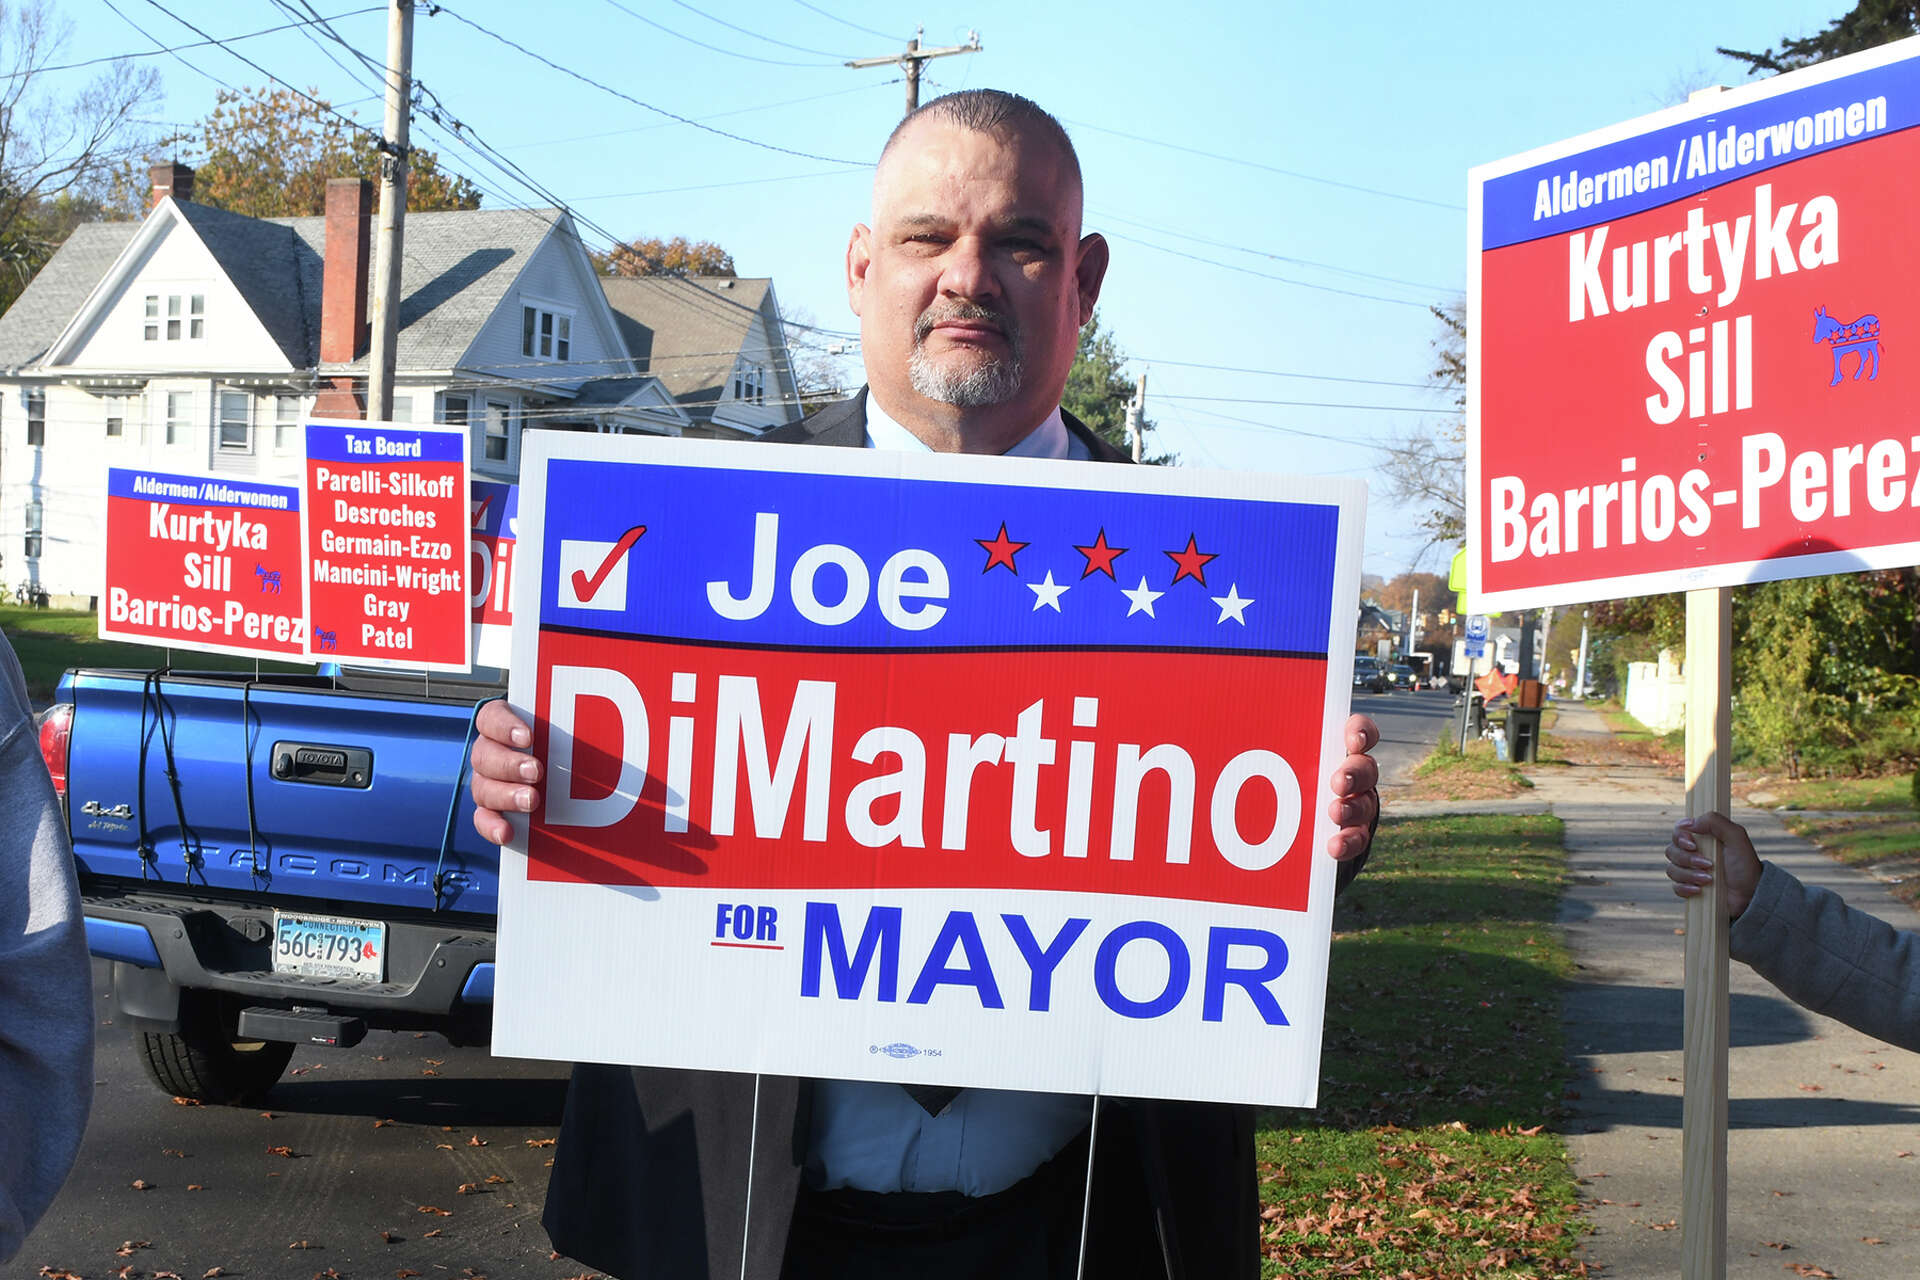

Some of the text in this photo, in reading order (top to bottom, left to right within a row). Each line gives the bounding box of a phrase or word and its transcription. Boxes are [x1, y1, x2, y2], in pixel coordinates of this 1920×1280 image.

[1533, 95, 1888, 222] Aldermen/Alderwomen
[1568, 183, 1840, 323] Kurtyka
[1645, 314, 1753, 425] Sill
[344, 434, 422, 458] Tax Board
[133, 475, 288, 509] Aldermen/Alderwomen
[316, 467, 455, 499] Parelli-Silkoff
[149, 502, 268, 551] Kurtyka
[334, 499, 437, 529] Desroches
[321, 529, 452, 561] Germain-Ezzo
[183, 552, 232, 592] Sill
[313, 559, 462, 594] Mancini-Wright
[706, 512, 950, 631] Joe
[110, 586, 304, 644] Barrios-Perez
[363, 593, 410, 623] Gray
[361, 623, 413, 650] Patel
[303, 751, 344, 767] TOYOTA
[543, 665, 1303, 871] DiMartino
[179, 842, 480, 893] TACOMA
[302, 920, 358, 935] CONNECTICUT
[715, 903, 778, 941] FOR
[800, 901, 1291, 1027] MAYOR
